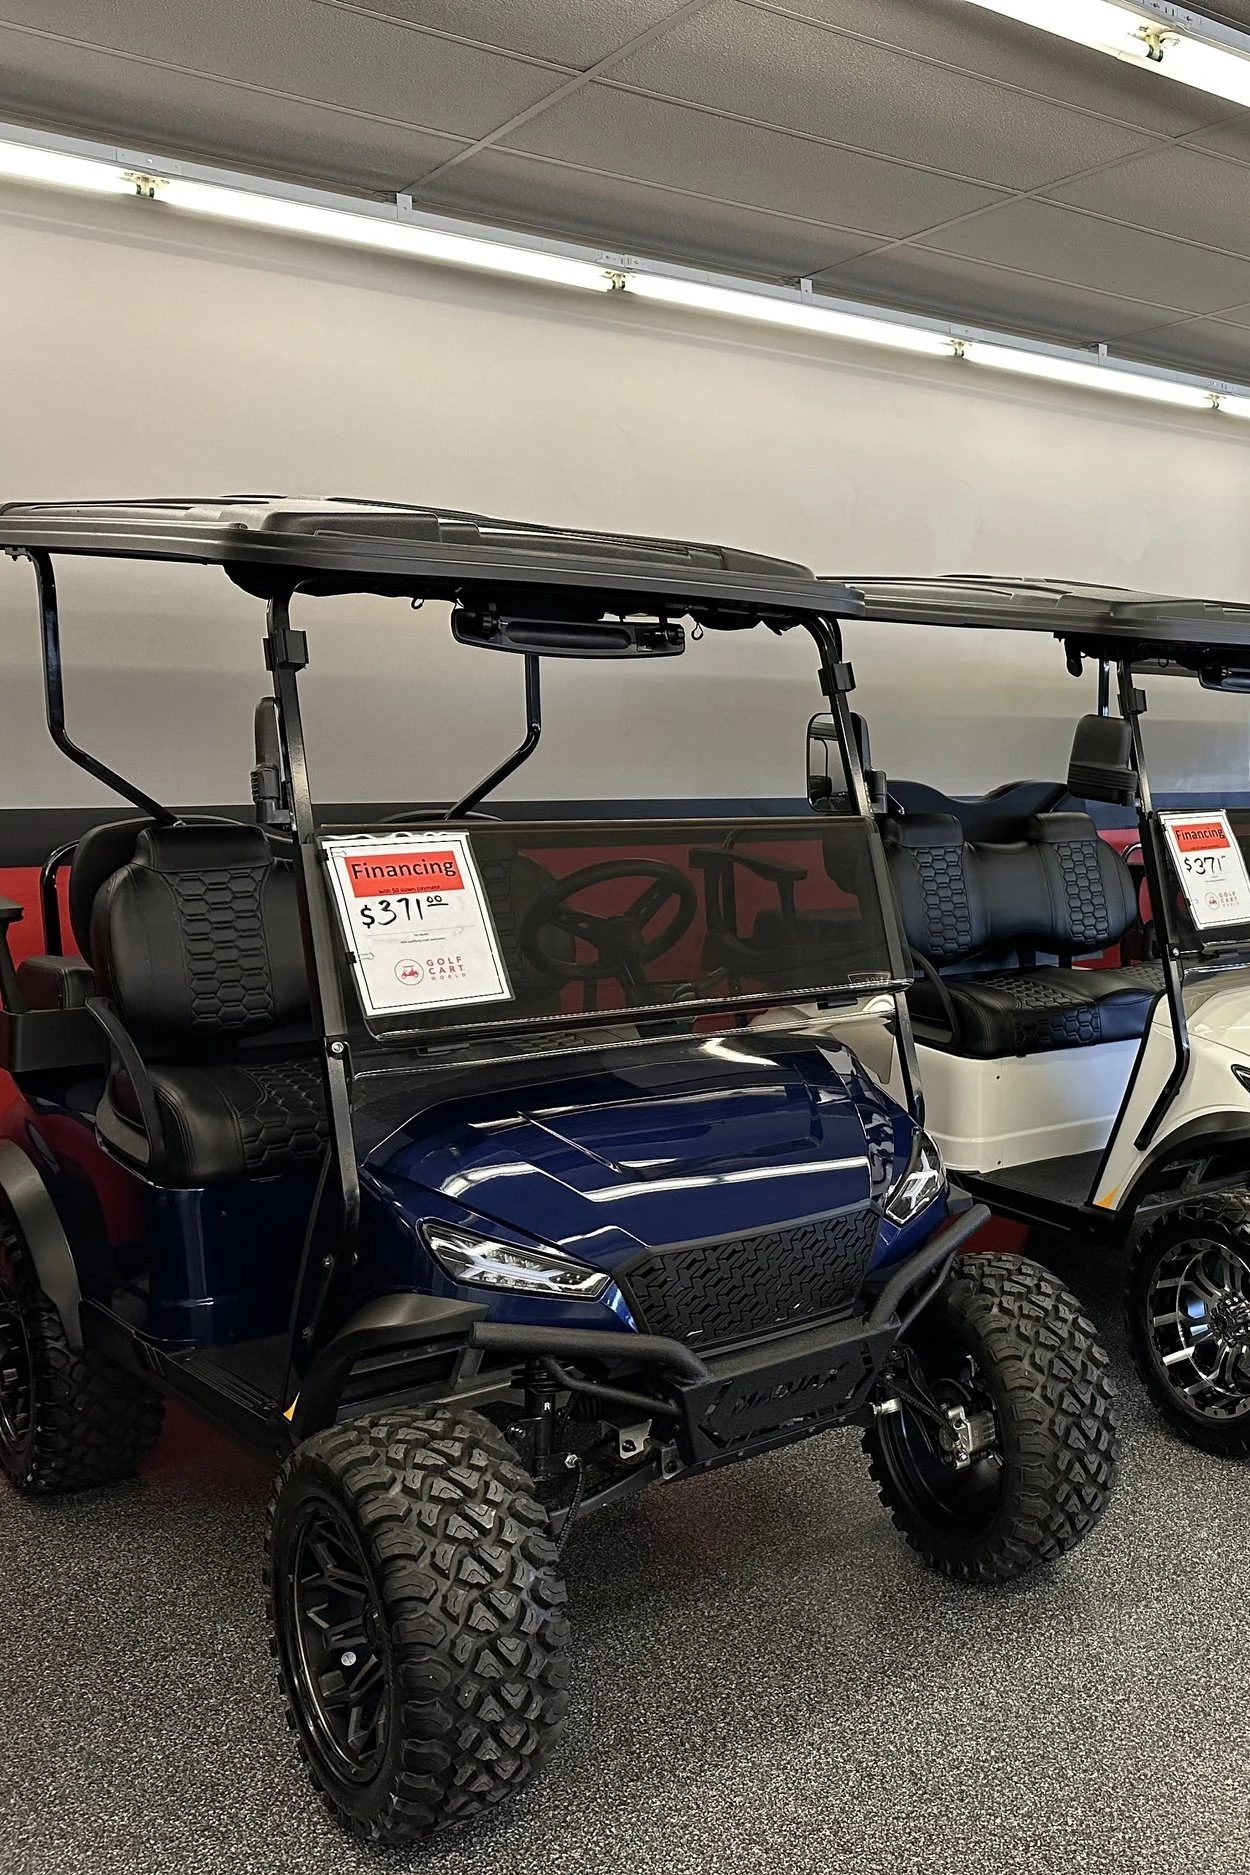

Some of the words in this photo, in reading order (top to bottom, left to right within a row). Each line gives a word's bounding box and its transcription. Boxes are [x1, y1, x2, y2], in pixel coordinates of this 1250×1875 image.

[1175, 828, 1226, 840] Financing
[351, 859, 457, 880] Financing
[426, 956, 462, 967] GOLF
[428, 964, 464, 975] CART
[431, 972, 466, 981] WORLD
[544, 1402, 551, 1411] R
